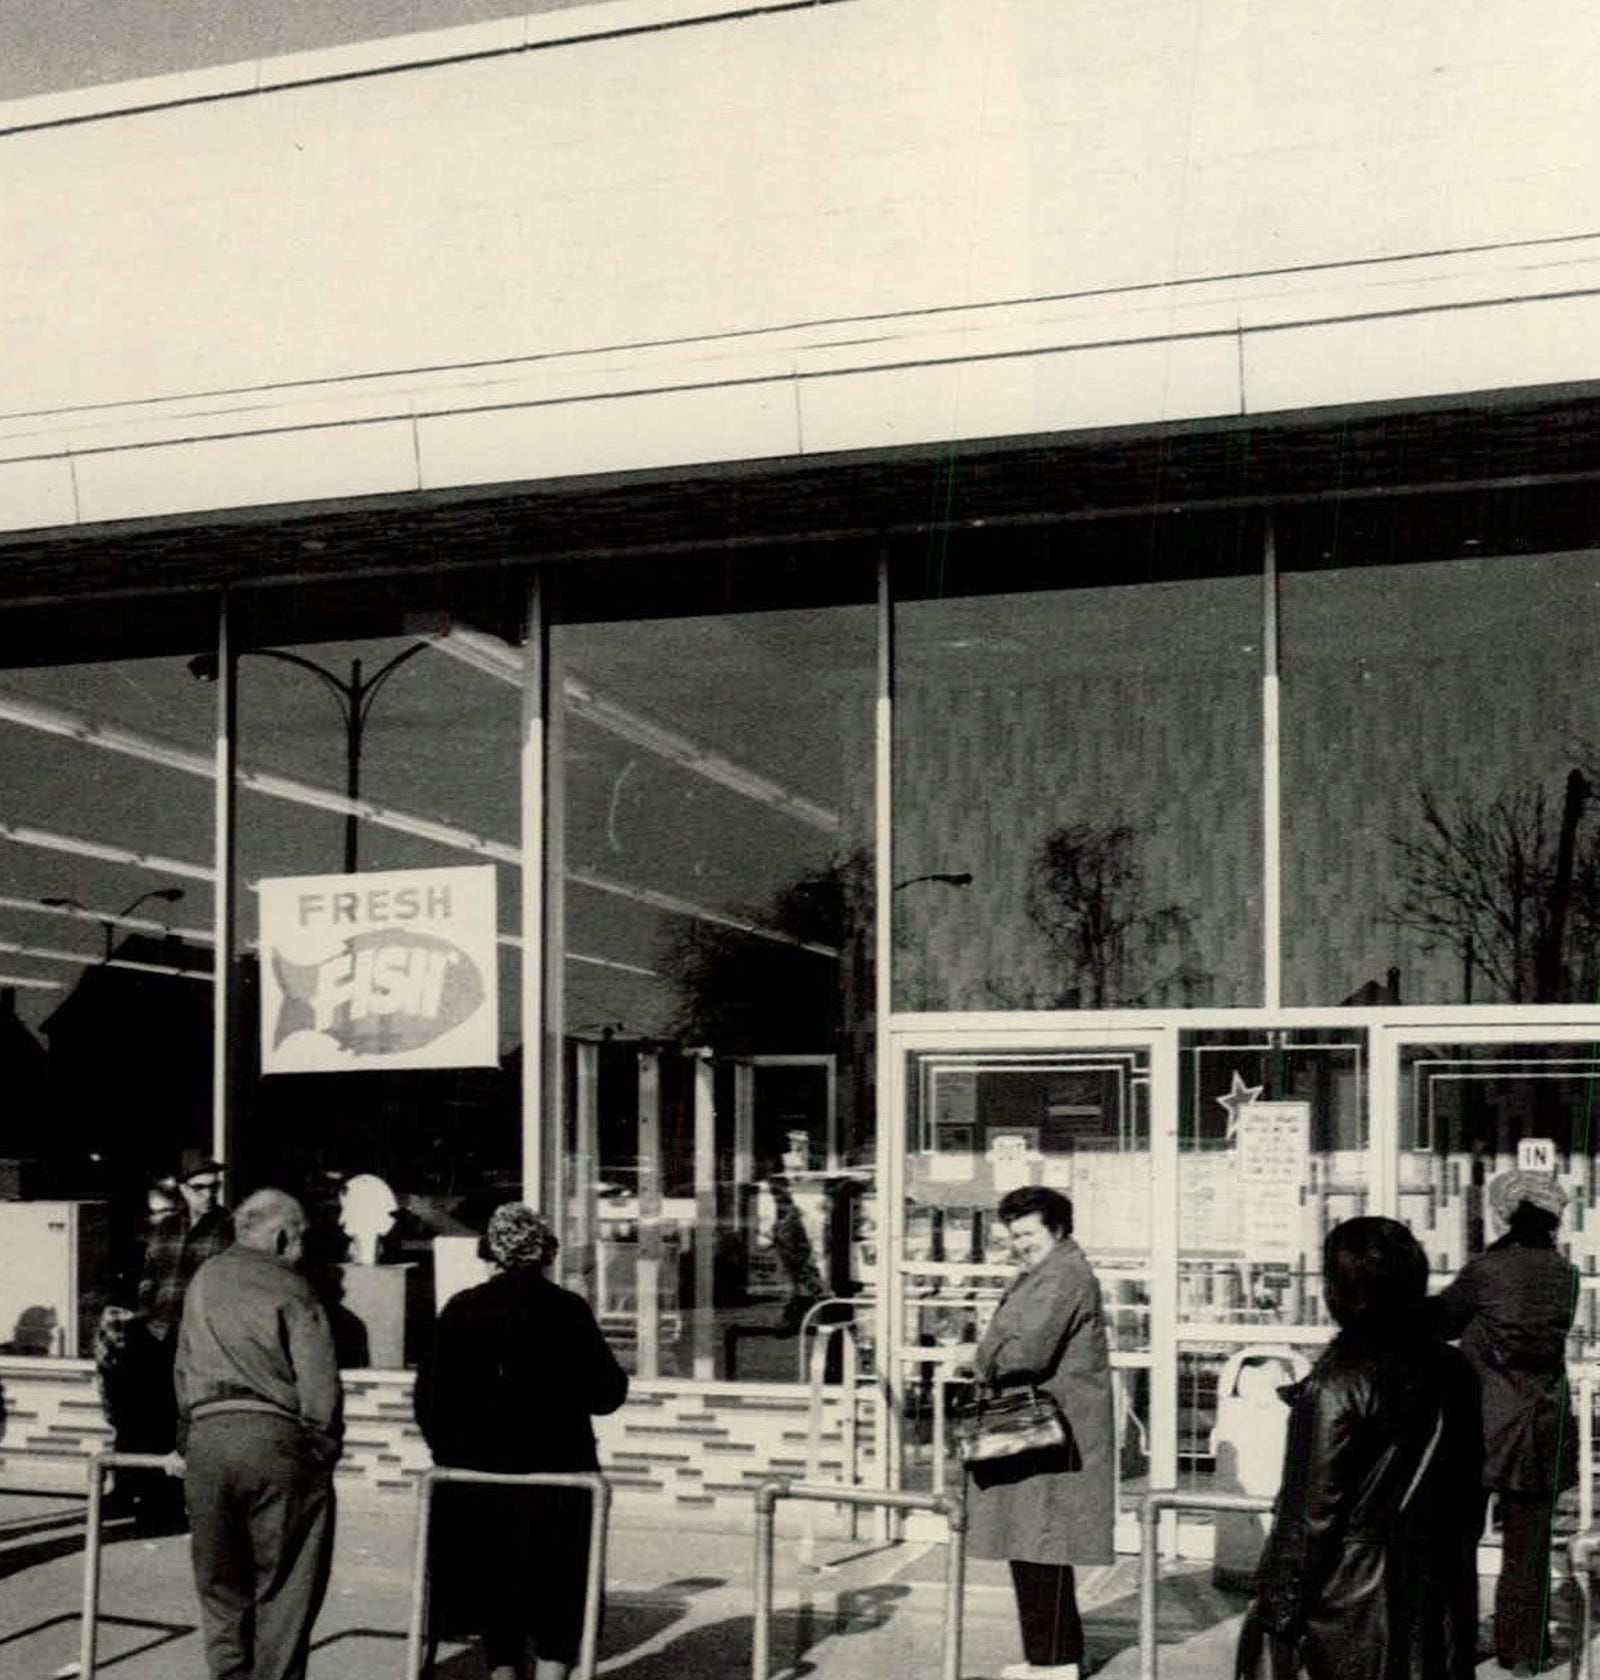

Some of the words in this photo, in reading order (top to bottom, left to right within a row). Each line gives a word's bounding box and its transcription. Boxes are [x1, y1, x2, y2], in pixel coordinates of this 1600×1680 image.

[297, 884, 453, 926] FRESH
[312, 946, 447, 1031] FISH
[1526, 1146, 1547, 1167] IN
